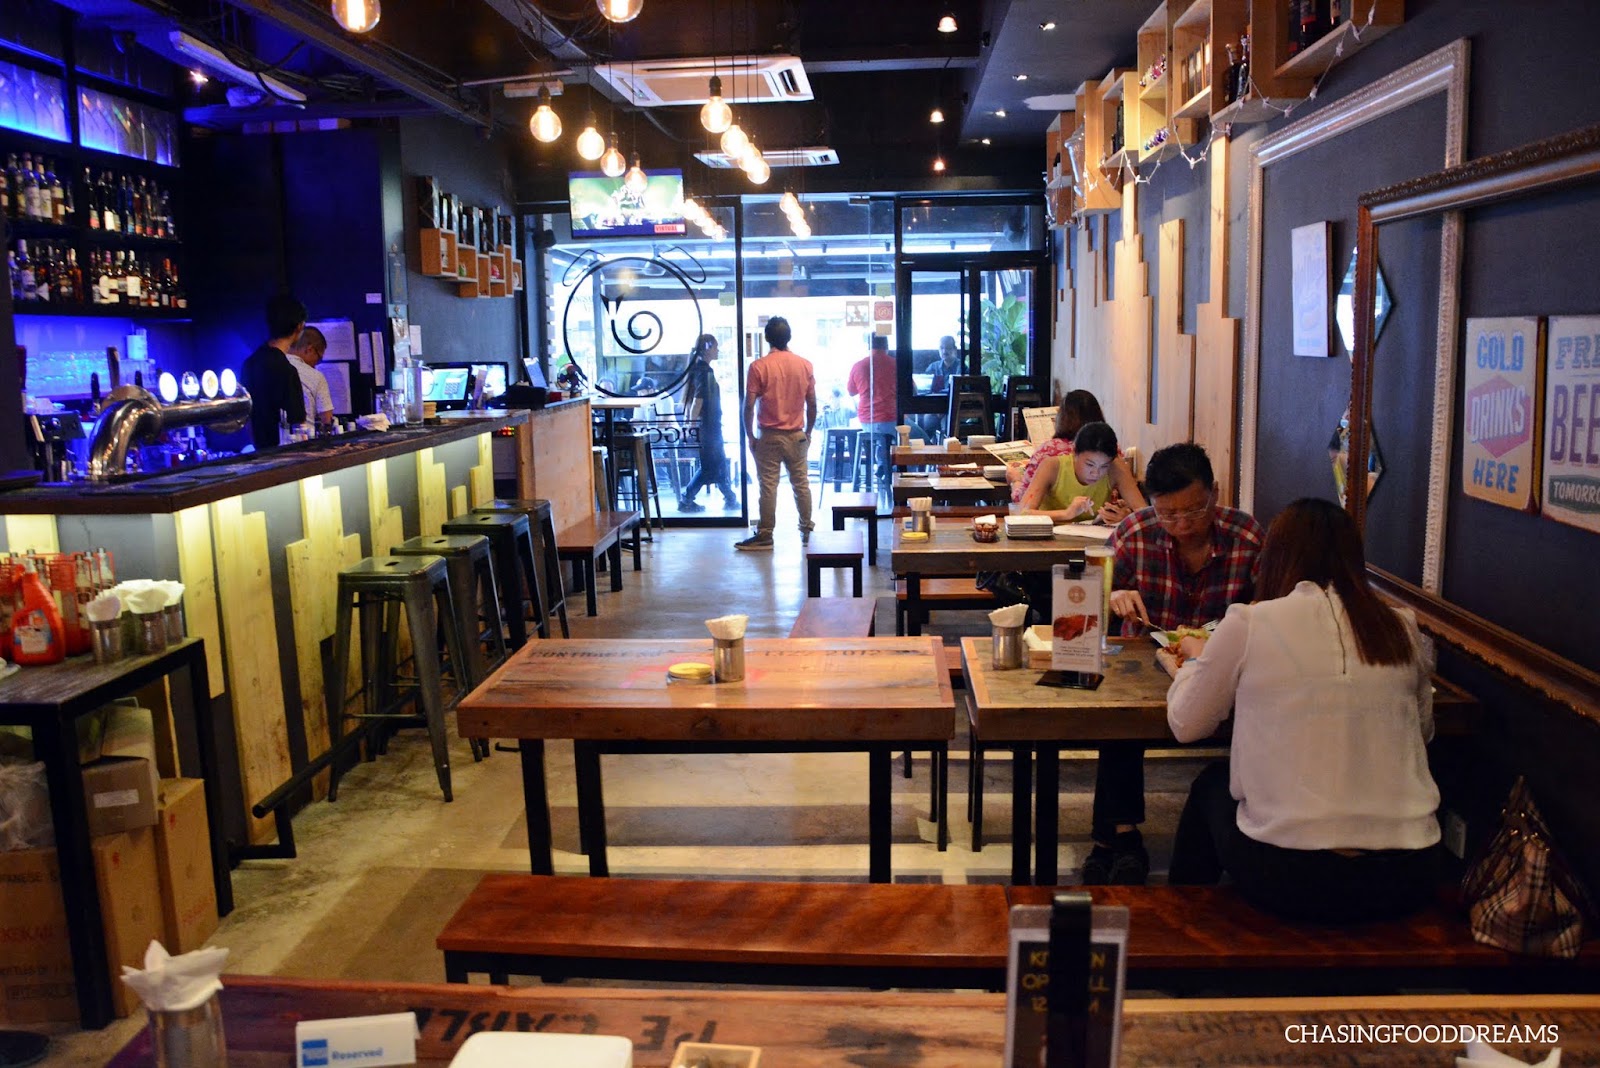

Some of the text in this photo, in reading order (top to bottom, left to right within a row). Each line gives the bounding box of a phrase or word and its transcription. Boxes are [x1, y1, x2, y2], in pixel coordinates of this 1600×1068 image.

[1476, 330, 1525, 372] COLD
[1471, 385, 1526, 443] DRINKS
[1473, 457, 1520, 494] HERE
[332, 1046, 384, 1060] Reserved
